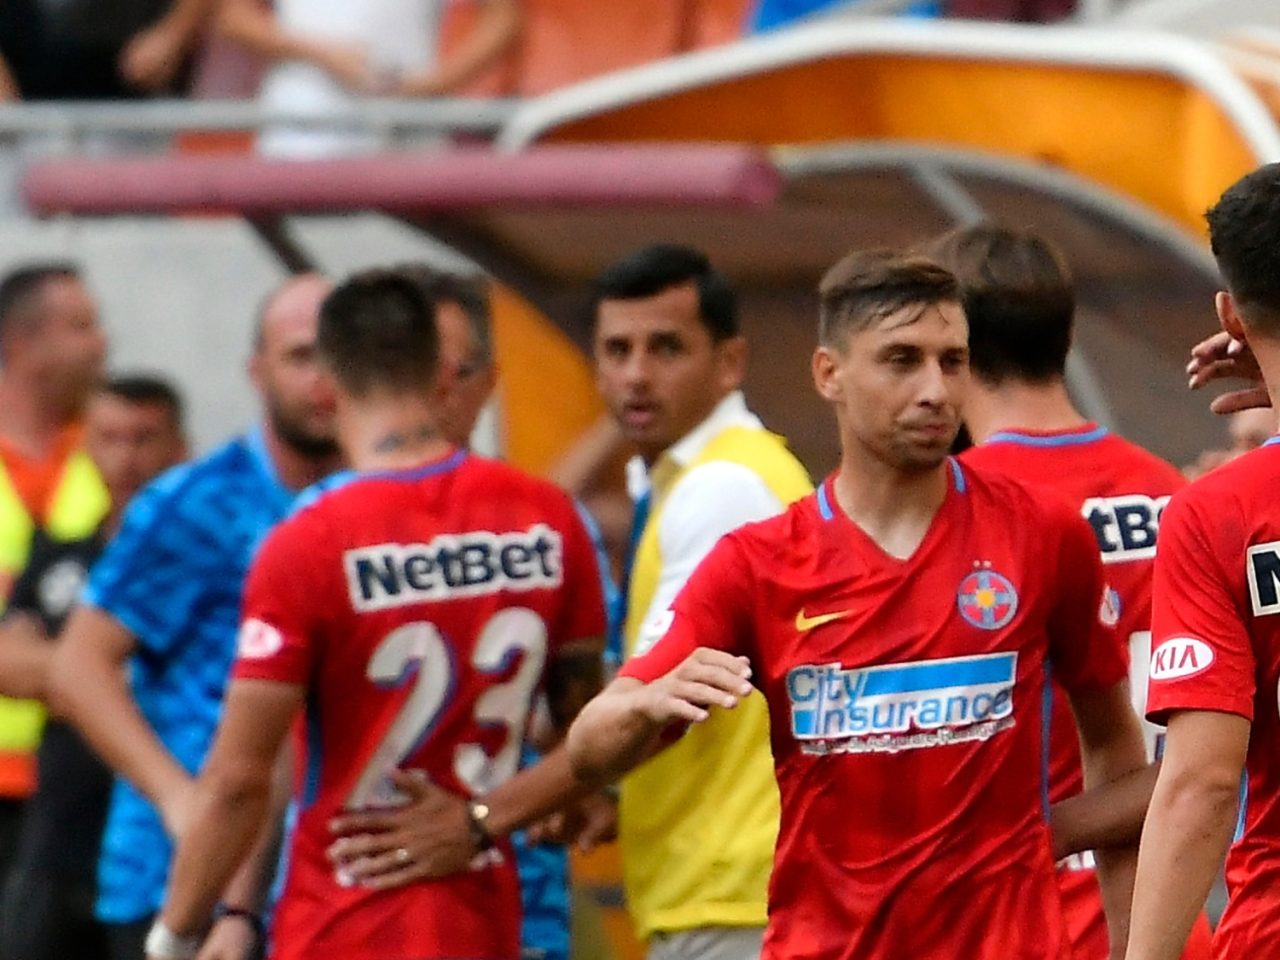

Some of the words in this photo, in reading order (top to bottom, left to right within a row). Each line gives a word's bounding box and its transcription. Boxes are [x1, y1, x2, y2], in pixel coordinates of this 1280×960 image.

[356, 535, 553, 600] NetBet
[1154, 645, 1198, 674] KIA
[348, 607, 549, 809] 23
[787, 667, 867, 706] City
